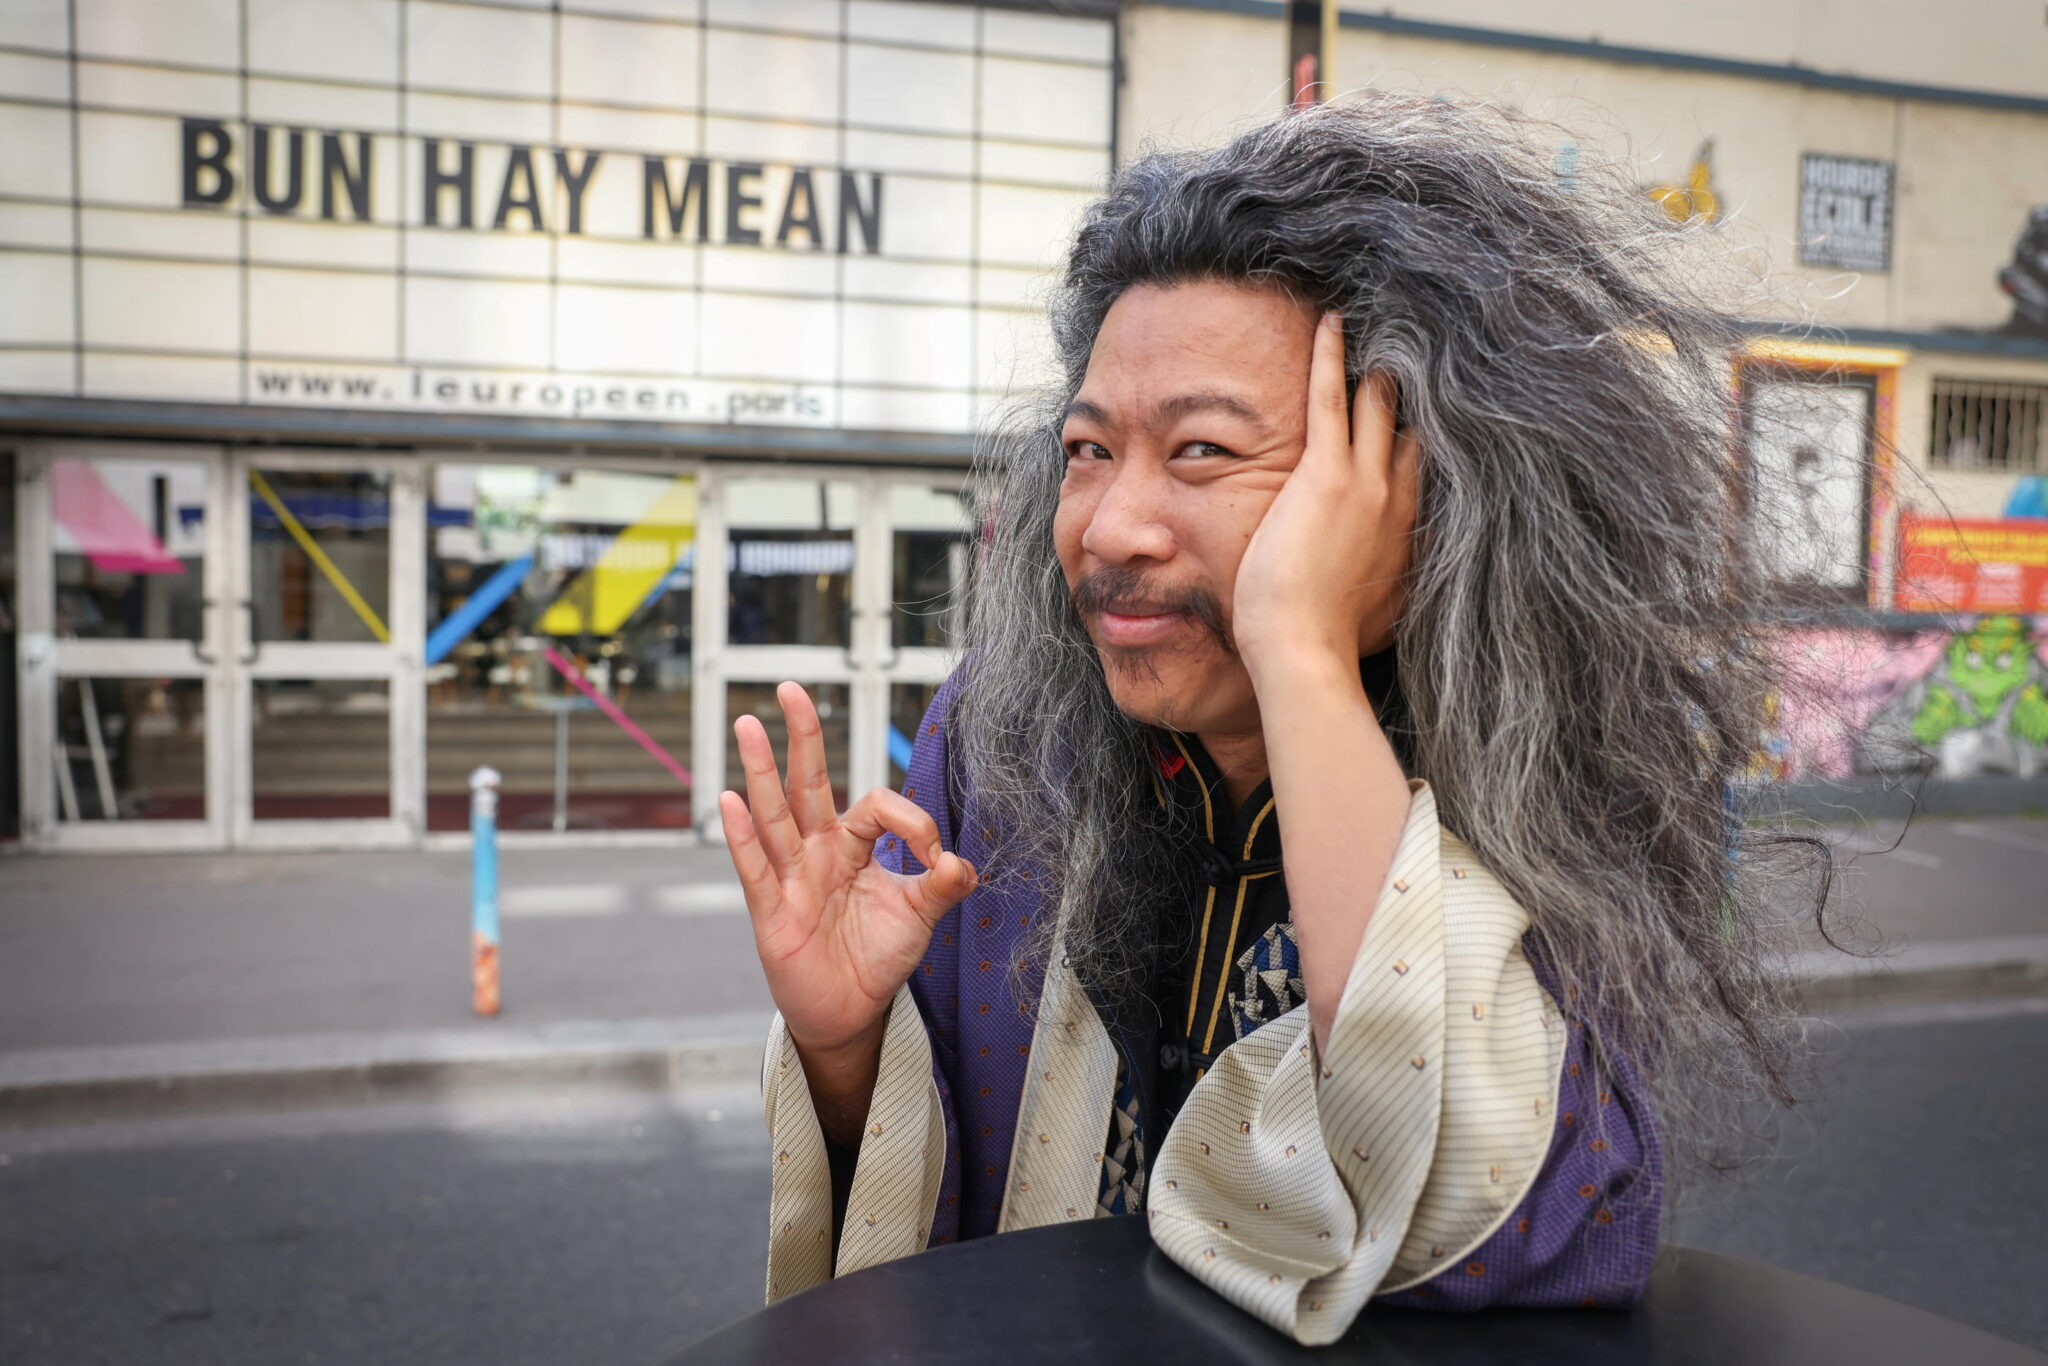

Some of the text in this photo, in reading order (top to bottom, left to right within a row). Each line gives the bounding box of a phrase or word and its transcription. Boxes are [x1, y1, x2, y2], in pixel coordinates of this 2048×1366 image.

[181, 117, 883, 254] BUN HAY MEAN
